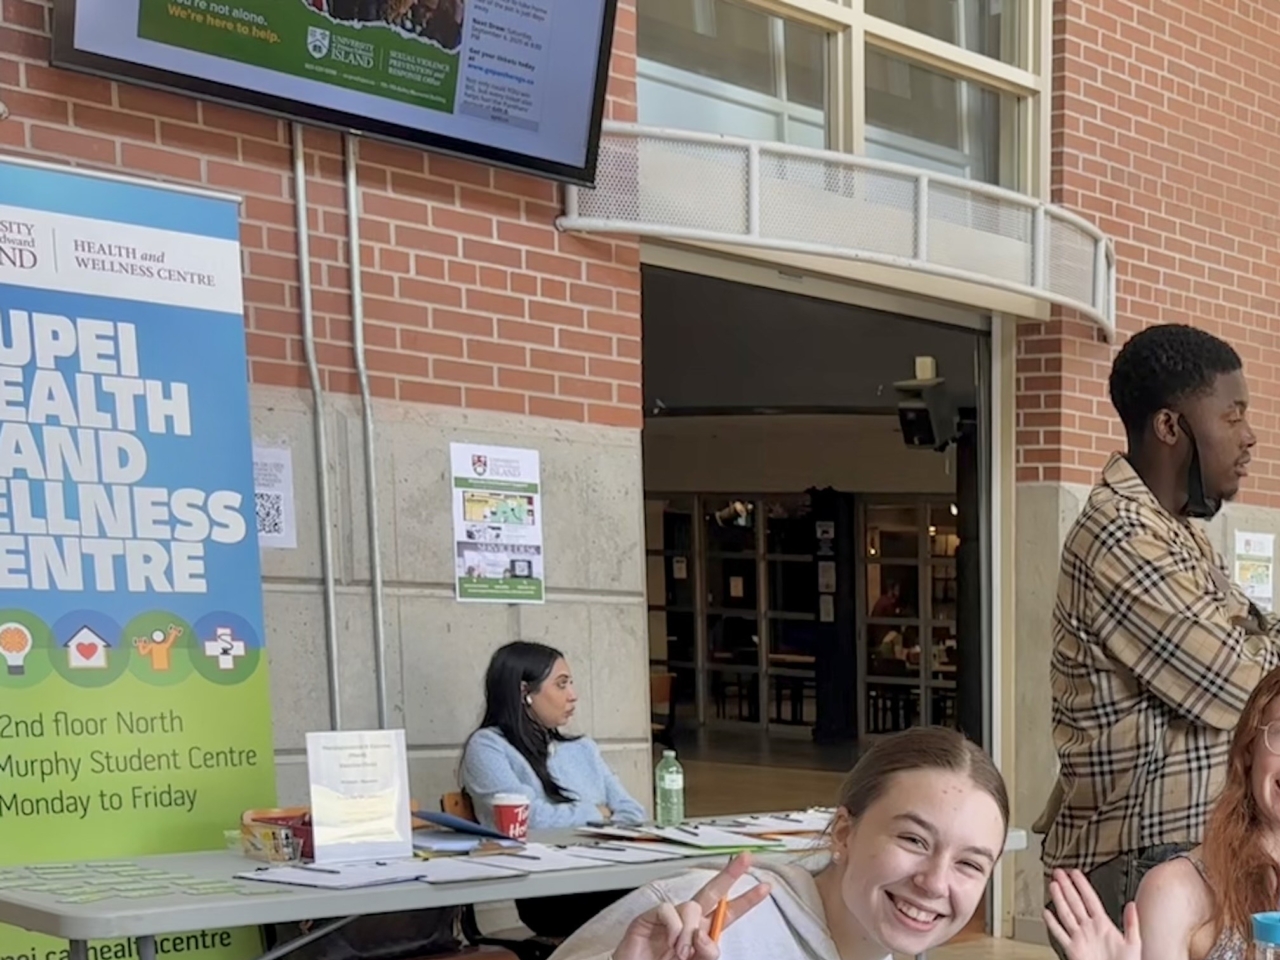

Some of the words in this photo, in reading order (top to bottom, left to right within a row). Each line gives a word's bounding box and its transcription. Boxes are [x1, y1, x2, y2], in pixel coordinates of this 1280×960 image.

[168, 4, 206, 23] We're
[206, 14, 234, 31] here
[236, 23, 249, 35] to
[252, 26, 281, 43] help.
[210, 3, 229, 16] not
[232, 8, 268, 26] alone.
[331, 45, 374, 69] ISLAND
[74, 239, 137, 260] HEALTH
[140, 252, 165, 264] and
[75, 256, 154, 278] WELLNESS
[157, 268, 216, 287] CENTRE
[0, 309, 139, 377] UPEI
[0, 422, 147, 484] AND
[0, 478, 246, 543] LLNESS
[0, 712, 43, 738] 2nd
[53, 711, 107, 737] floor
[116, 709, 183, 734] North
[0, 751, 81, 783] Murphy
[90, 748, 181, 775] Student
[188, 746, 257, 769] Centre
[0, 789, 90, 819] Monday
[99, 789, 123, 811] to
[132, 784, 197, 813] Friday
